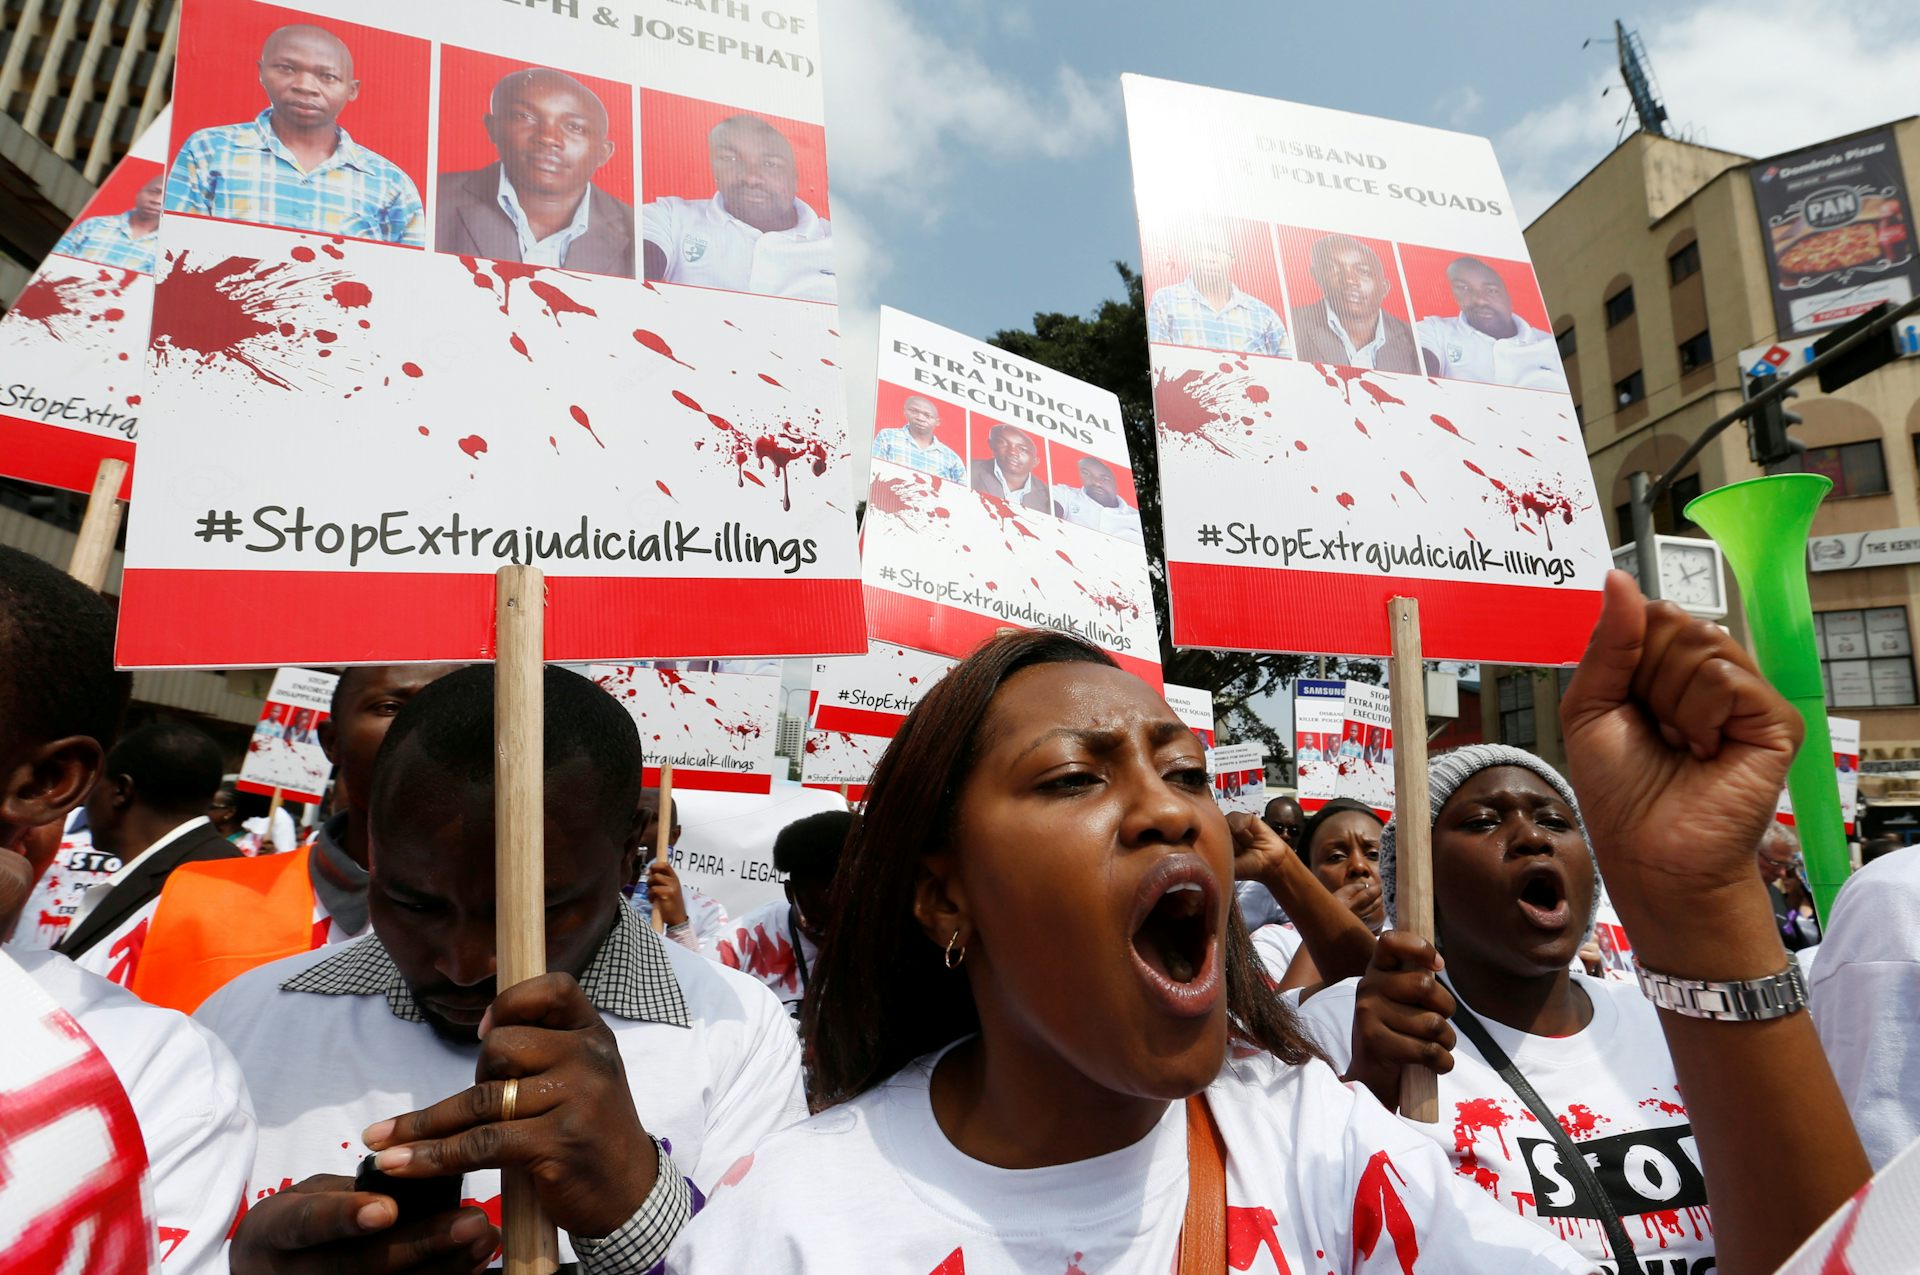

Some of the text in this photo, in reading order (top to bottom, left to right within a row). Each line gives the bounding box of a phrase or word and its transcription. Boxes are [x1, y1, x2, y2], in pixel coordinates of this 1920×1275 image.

[592, 6, 620, 29] &
[632, 15, 815, 78] JOSEPHAT)
[761, 10, 806, 34] OF
[1256, 135, 1387, 170] DISBAND
[1271, 163, 1380, 196] POLICE
[1387, 183, 1503, 216] SQUADS
[1807, 194, 1856, 221] PAN
[893, 340, 1117, 434] EXTRA JUDICIAL
[972, 350, 1042, 384] STOP
[914, 368, 1094, 445] EXECUTIONS
[194, 505, 818, 575] #StopExtrajudicialKillings
[1198, 522, 1576, 586] #StopExtrajudicialKillings
[1890, 539, 1920, 552] KENY
[879, 566, 1132, 651] #StopExtrajudicialKillings
[1348, 696, 1391, 713] EXTRA JUD
[1370, 690, 1390, 701] STOP
[688, 852, 724, 876] PARA
[1532, 1136, 1704, 1208] SO
